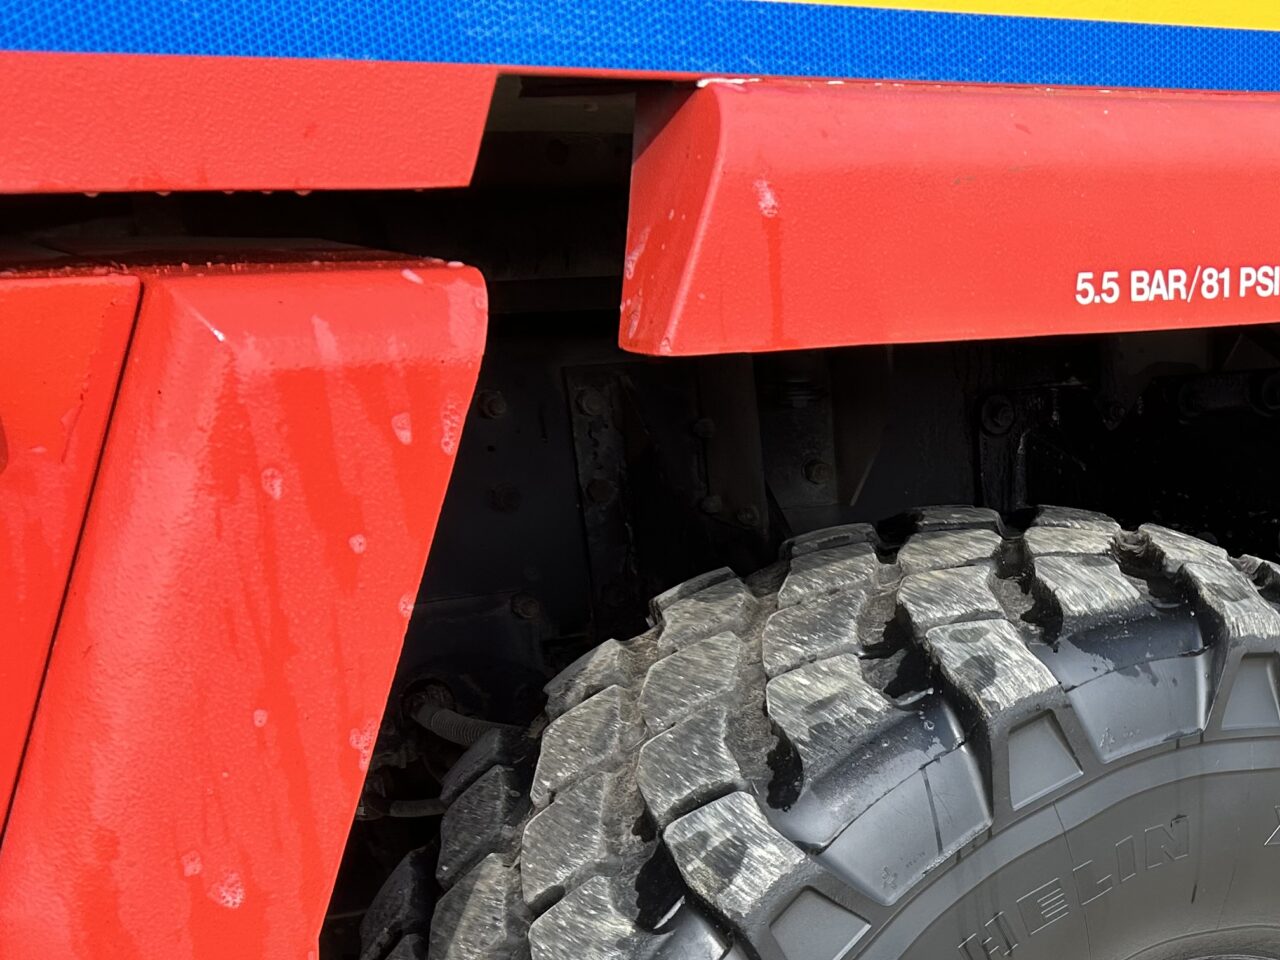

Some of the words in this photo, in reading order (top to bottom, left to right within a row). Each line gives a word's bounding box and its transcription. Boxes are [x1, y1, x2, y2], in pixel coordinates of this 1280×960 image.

[1075, 271, 1120, 305] 5.5
[1130, 265, 1230, 303] BAR/81
[1239, 265, 1280, 298] PSI
